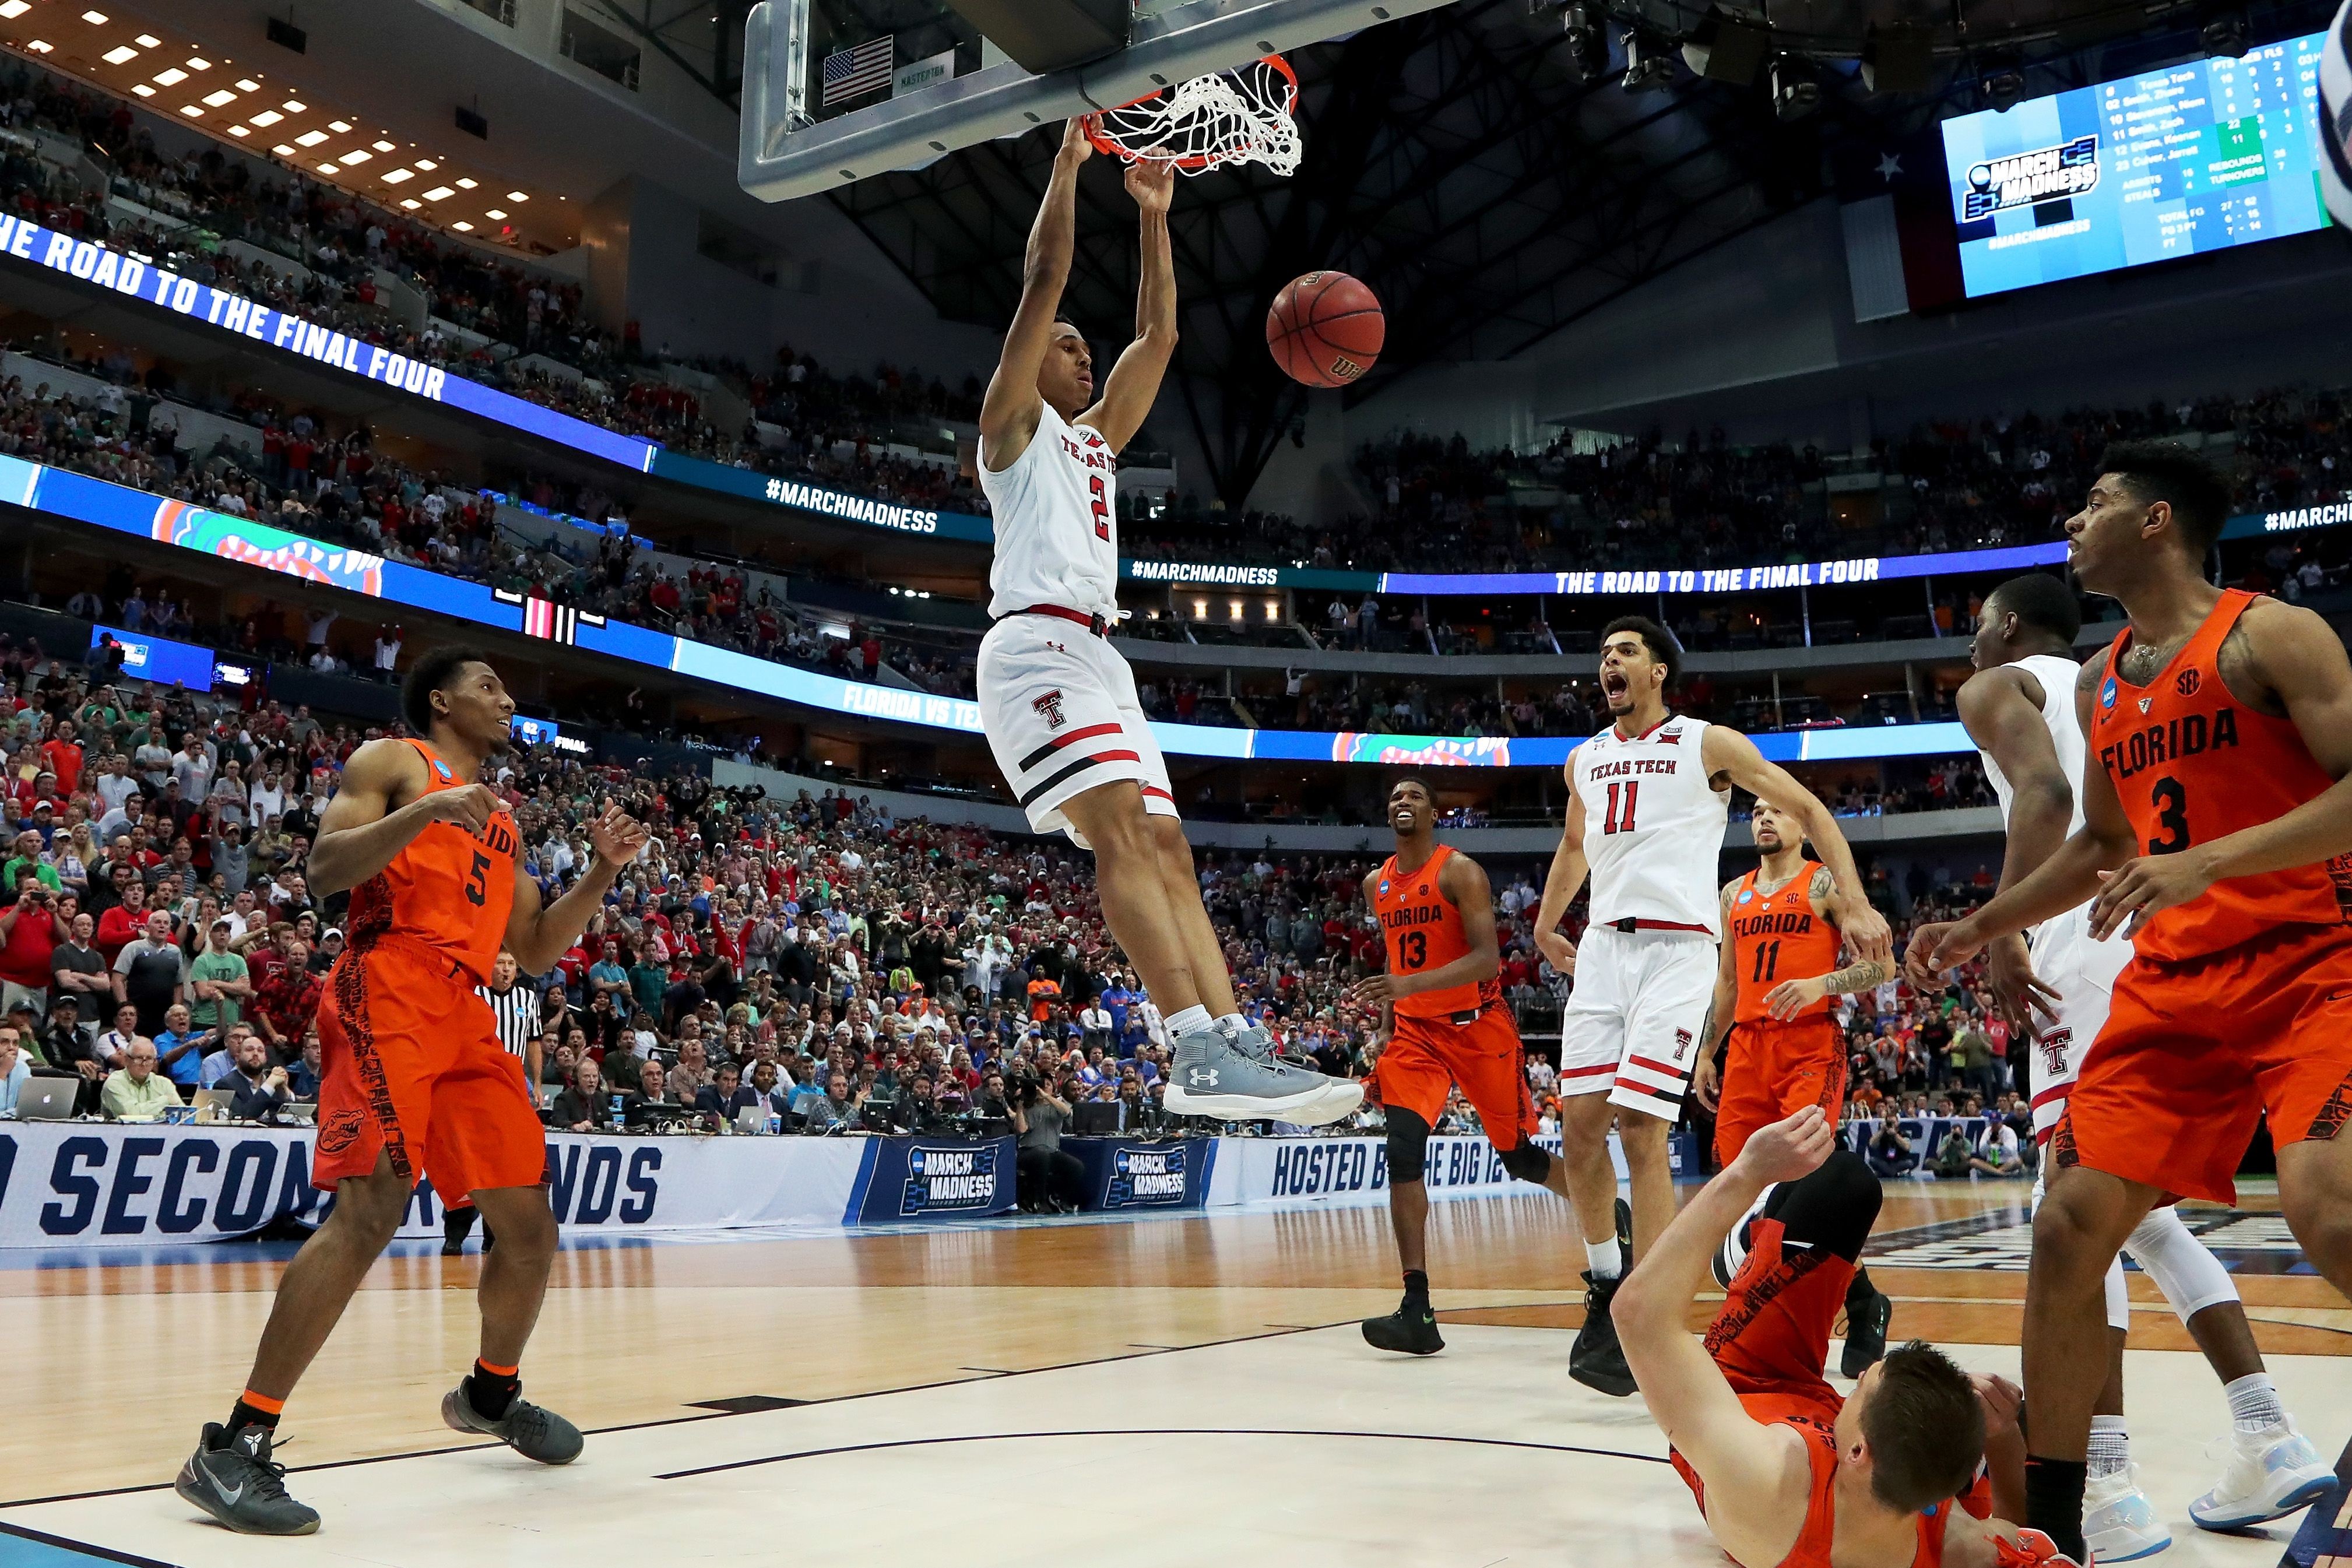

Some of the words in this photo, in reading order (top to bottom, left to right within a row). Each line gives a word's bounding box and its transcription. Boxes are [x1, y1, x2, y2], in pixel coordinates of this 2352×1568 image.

[2110, 114, 2124, 125] 10
[2227, 118, 2241, 130] 22
[2112, 129, 2126, 141] 11
[2231, 133, 2244, 145] 11
[1990, 149, 2061, 185] MARCH
[2208, 153, 2263, 173] REBOUNDS
[2209, 166, 2266, 185] TURNOVERS
[2001, 163, 2097, 203] MADNESS
[2158, 209, 2189, 224] TOTAL
[44, 231, 145, 296] ROAD
[154, 268, 199, 314] TO
[208, 288, 271, 340] THE
[273, 314, 360, 374] FINAL
[367, 346, 447, 402] FOUR
[1061, 434, 1106, 470] TEAS
[765, 478, 938, 533] #MARCHMADNESS
[1089, 474, 1110, 543] 2
[2265, 502, 2352, 532] #MARCH
[1132, 560, 1278, 585] #MARCHMADNESS
[1556, 572, 1597, 594] THE
[1601, 571, 1661, 593] ROAD
[1668, 570, 1697, 592] TO
[1702, 568, 1743, 592] THE
[1749, 563, 1812, 590] FINAL
[1819, 557, 1880, 584] FOUR
[843, 684, 922, 720] FLORIDA
[926, 698, 950, 725] VS
[522, 720, 539, 735] 62
[554, 735, 587, 753] FINAL
[2100, 707, 2240, 779] FLORIDA
[1590, 760, 1631, 782] TEXAS
[1634, 760, 1677, 775] TECH
[1604, 781, 1639, 835] 11
[2149, 775, 2191, 856] 3
[465, 848, 491, 907] 5
[1785, 892, 1800, 904] SEC
[1380, 904, 1443, 929] FLORIDA
[1734, 913, 1812, 940] FLORIDA
[1398, 931, 1427, 969] 13
[1753, 940, 1781, 983] 11
[924, 1153, 973, 1176] MARCH
[1128, 1154, 1166, 1174] MARCH
[1271, 1143, 1367, 1197] HOSTED
[1370, 1144, 1391, 1190] B
[1422, 1142, 1445, 1187] HE
[1448, 1141, 1481, 1186] BIG
[39, 1136, 337, 1236] SECON
[930, 1174, 994, 1200] MADNESS
[1134, 1172, 1184, 1195] MADNESS
